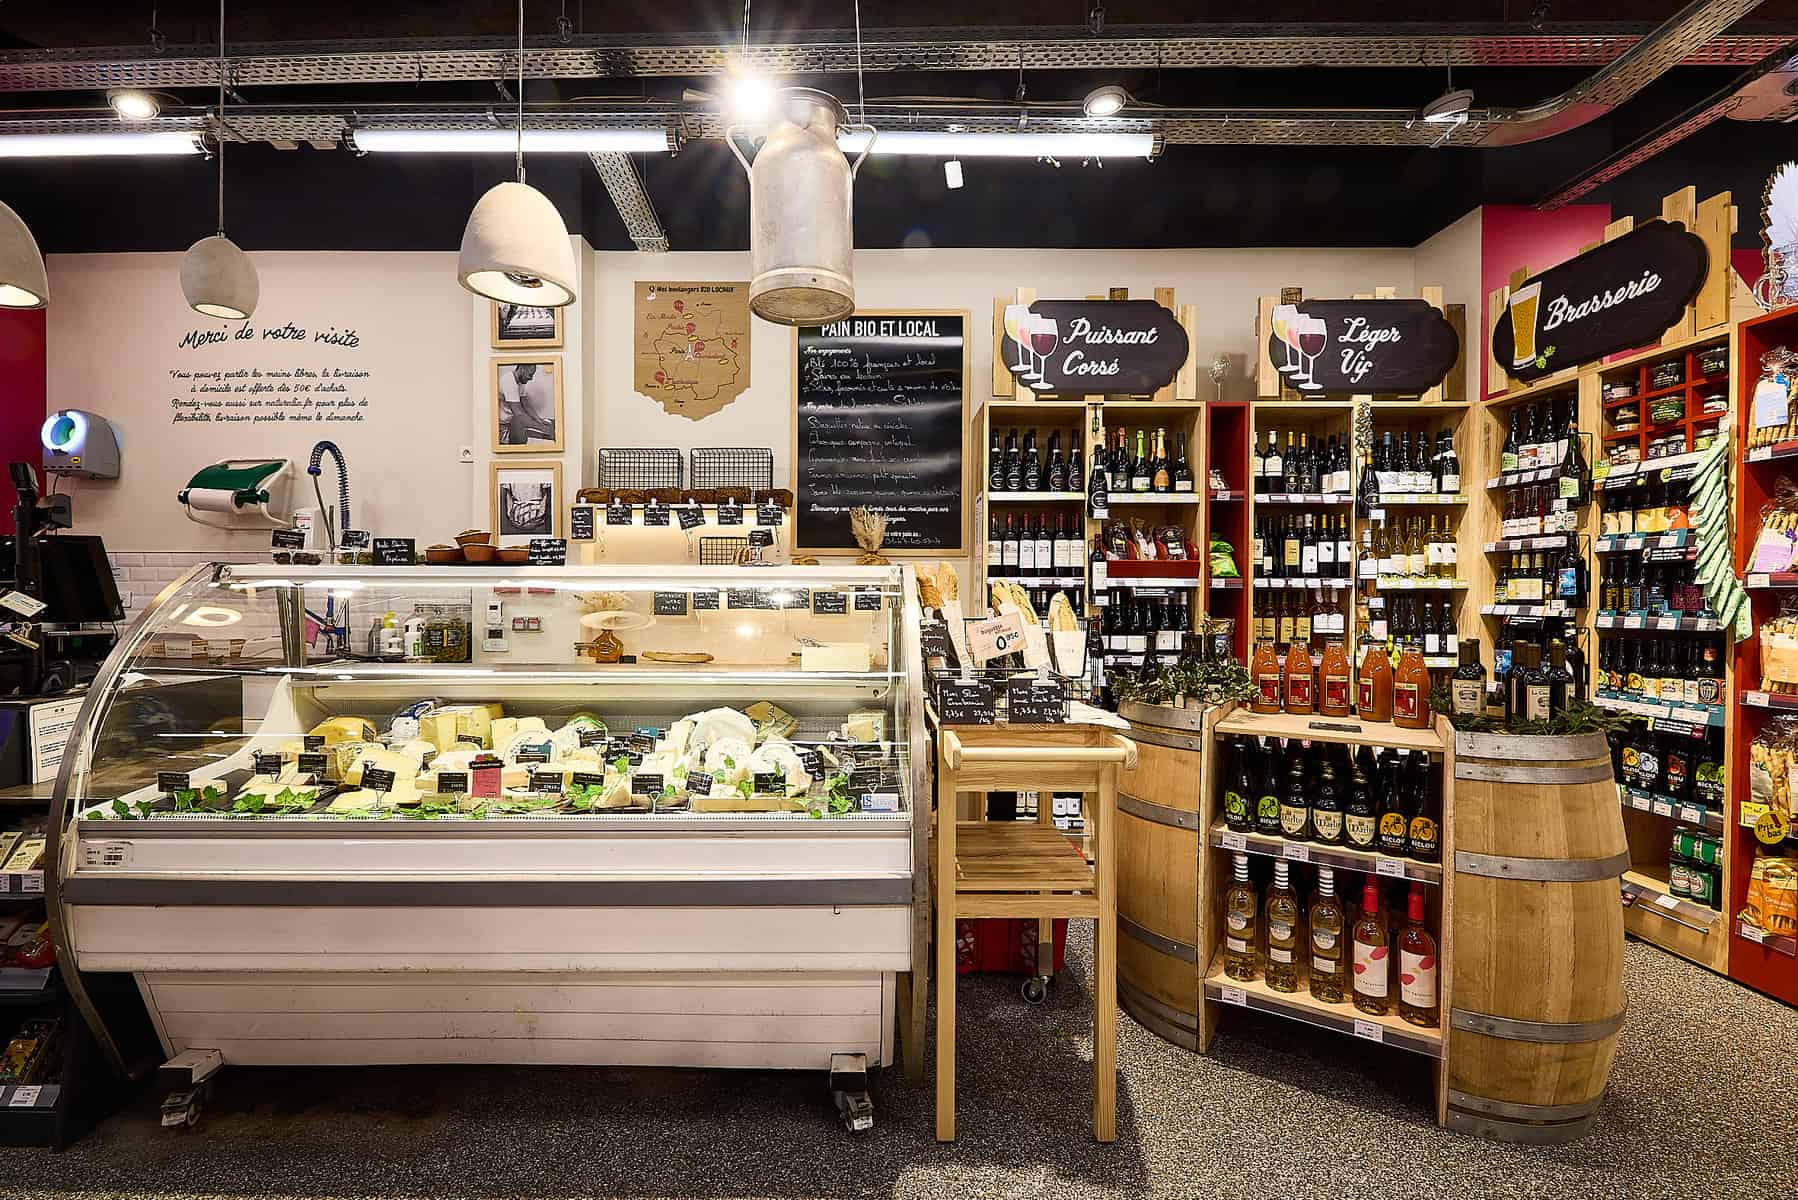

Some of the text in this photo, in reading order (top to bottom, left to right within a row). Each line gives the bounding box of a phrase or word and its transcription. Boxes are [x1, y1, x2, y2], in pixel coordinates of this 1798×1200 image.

[1543, 269, 1662, 331] Brasserie
[178, 320, 360, 349] Merci de votre visite
[821, 320, 940, 337] PAIN BIO ET LOCAL
[1062, 317, 1159, 344] Puissant
[1337, 317, 1402, 352] Léger
[169, 369, 192, 379] Vous
[193, 370, 222, 382] pouvez
[224, 368, 249, 381] partir
[333, 367, 370, 378] livraison
[1062, 350, 1120, 375] Corsé
[1340, 348, 1373, 384] Vif
[199, 382, 232, 393] domicile
[234, 382, 247, 393] est
[248, 382, 275, 396] offerte
[277, 382, 291, 393] dès
[293, 383, 312, 393] 50€
[170, 397, 223, 410] Rendez-vous
[315, 400, 336, 410] pour
[337, 396, 356, 410] plus
[358, 396, 369, 407] de
[214, 411, 251, 422] livraison
[253, 410, 286, 425] possible
[288, 412, 313, 422] même
[315, 410, 323, 421] le
